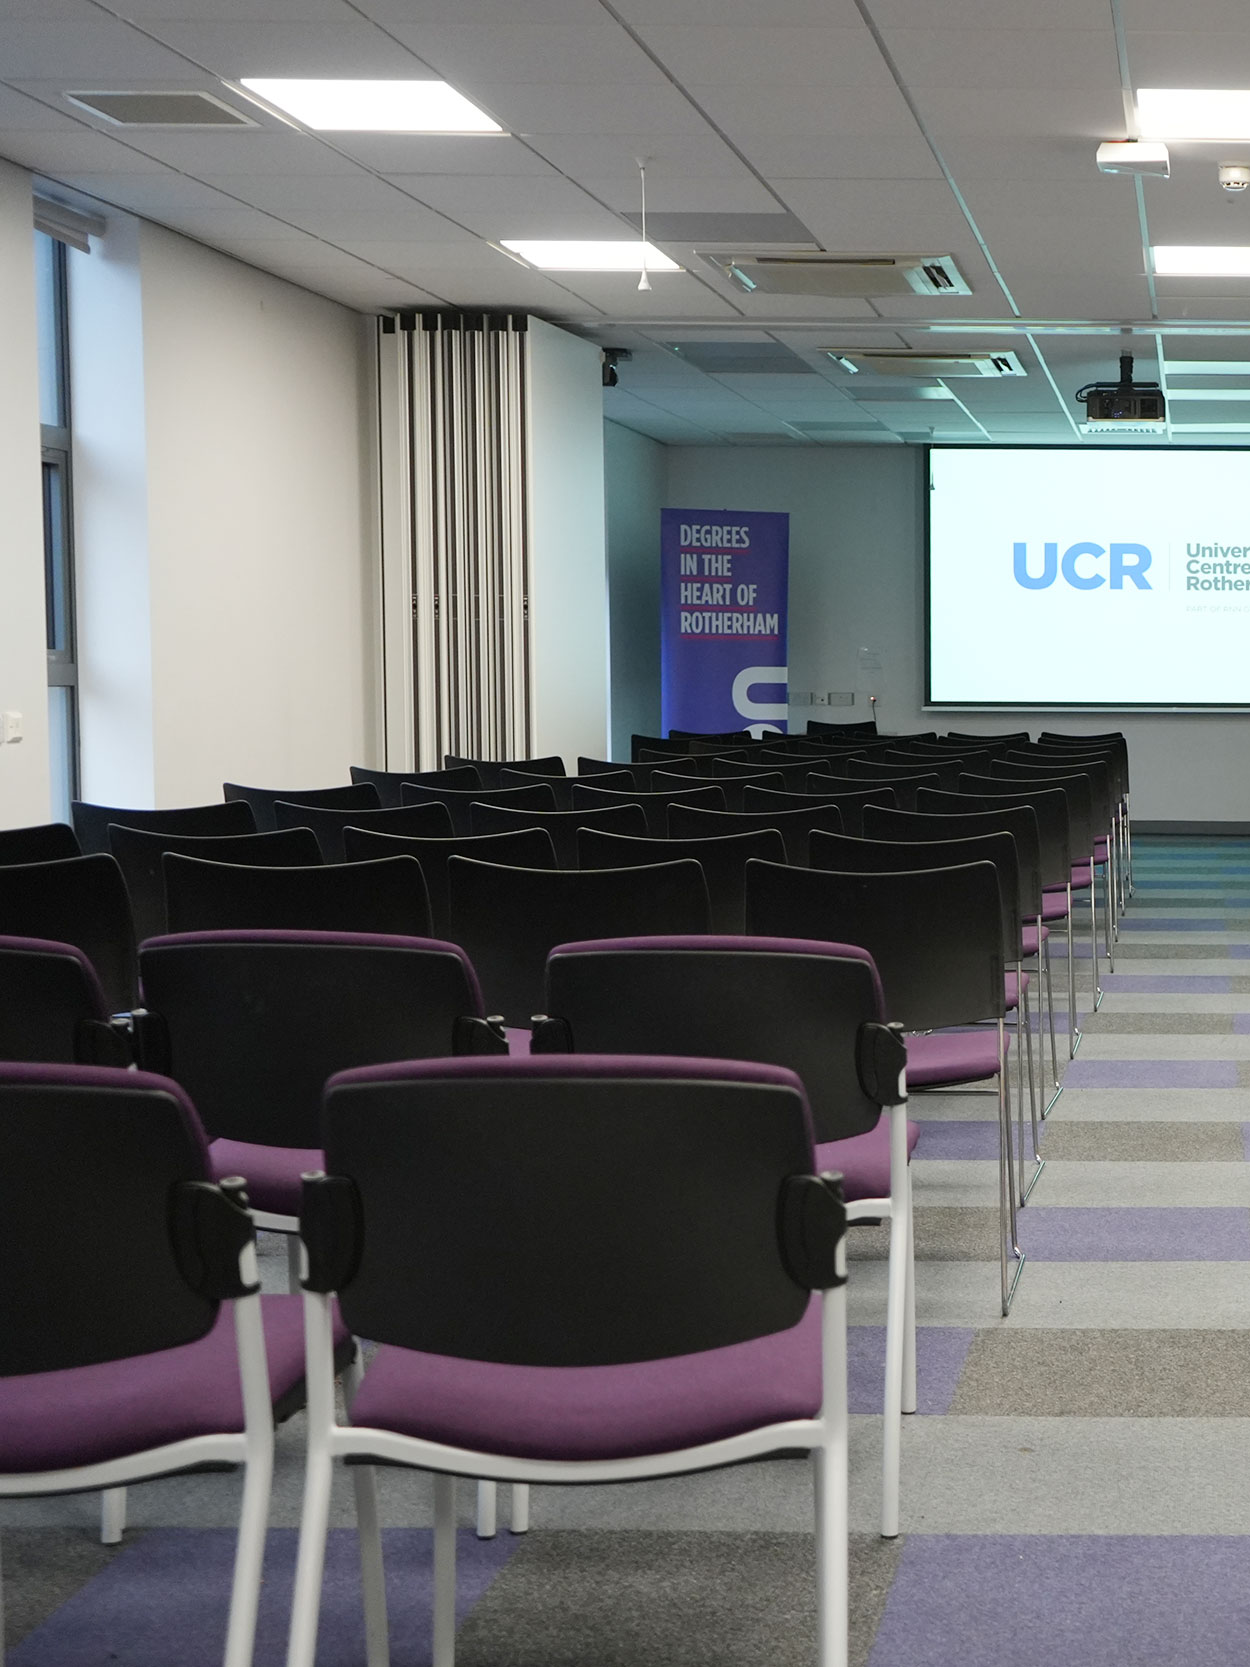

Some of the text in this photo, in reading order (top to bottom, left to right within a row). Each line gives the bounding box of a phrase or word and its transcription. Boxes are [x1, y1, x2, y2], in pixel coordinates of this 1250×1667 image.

[680, 524, 750, 548] DEGREES
[680, 553, 732, 577] IN THE
[1013, 542, 1153, 590] UCR
[680, 582, 757, 606] HEART OF
[680, 611, 779, 635] ROTHERHAM
